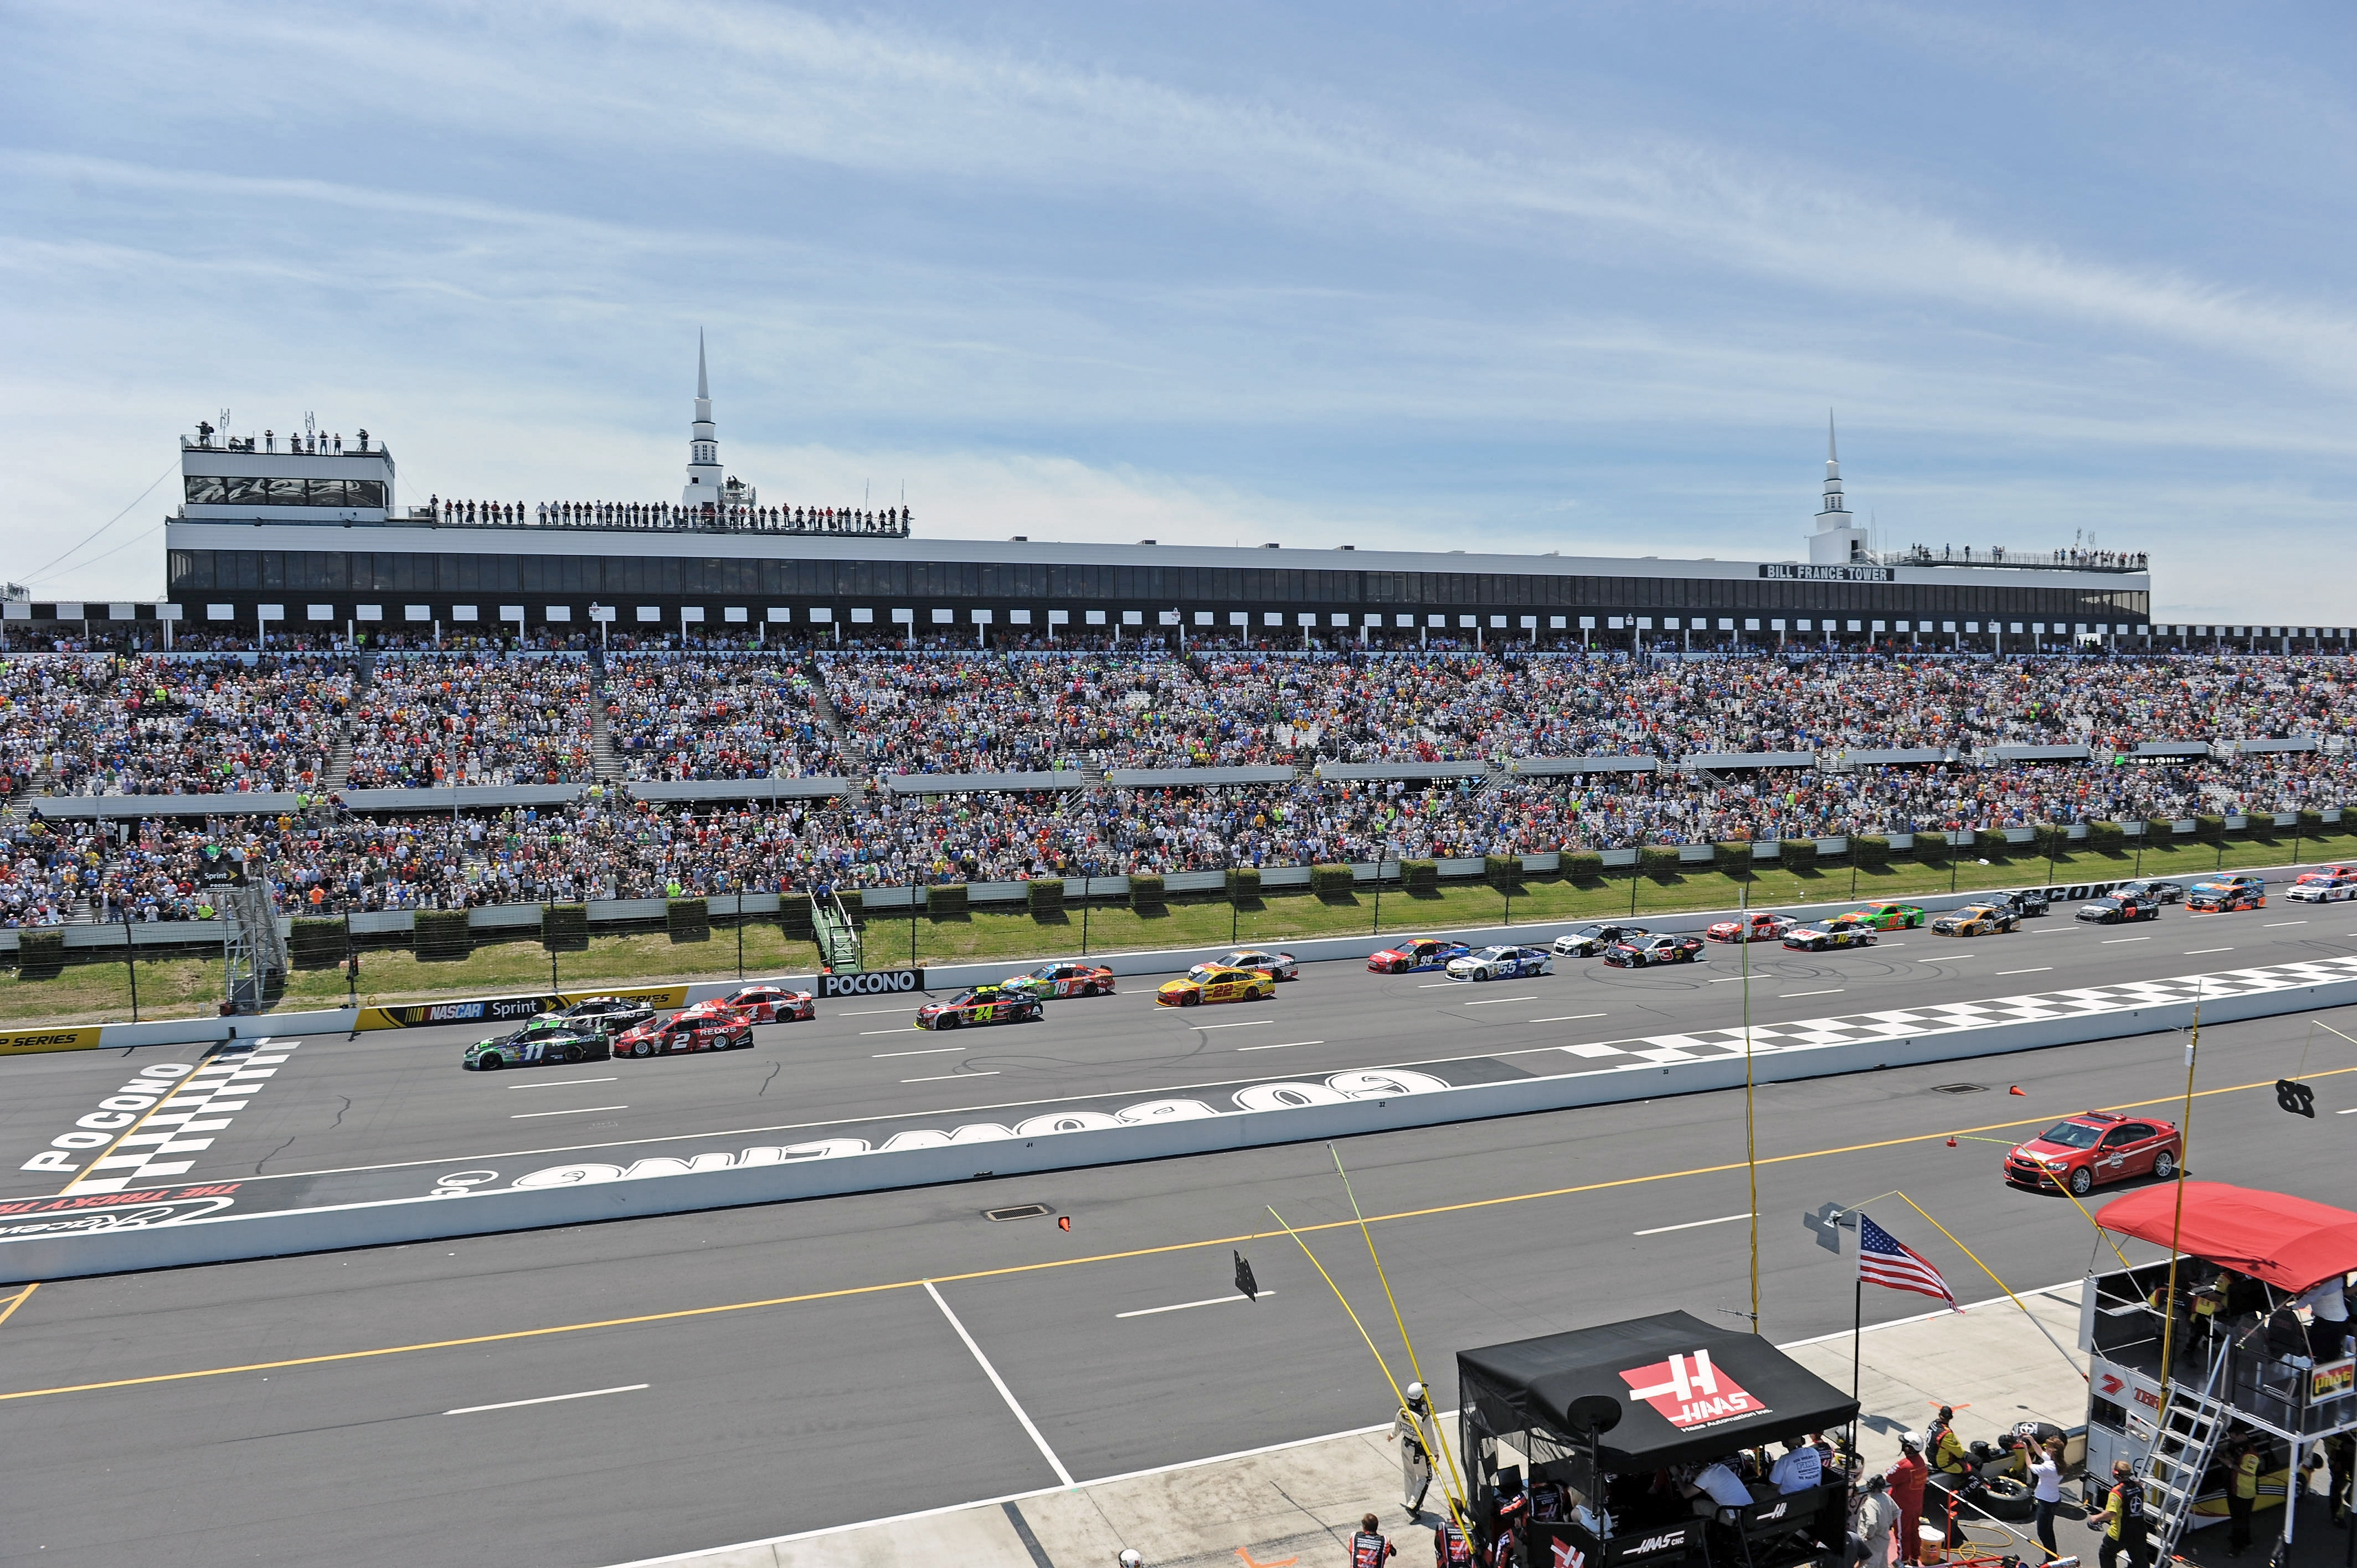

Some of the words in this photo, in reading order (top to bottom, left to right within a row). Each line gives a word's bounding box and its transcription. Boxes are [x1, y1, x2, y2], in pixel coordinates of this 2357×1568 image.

[1767, 565, 1793, 578] BILL
[1797, 566, 1844, 579] FRANCE
[1847, 568, 1887, 581] TOWER
[1757, 926, 1772, 937] 42
[1983, 919, 1994, 931] 31
[1836, 933, 1849, 944] 16
[1419, 955, 1434, 967] 99
[1658, 948, 1674, 962] 3
[1499, 960, 1518, 975] 55
[826, 971, 915, 996] POCONO
[1053, 981, 1070, 994] 18
[1212, 984, 1234, 997] 22
[430, 1003, 482, 1020] NASCAR
[492, 1000, 537, 1018] Sprint
[748, 1005, 759, 1019] 4
[974, 1005, 994, 1021] 24
[699, 1027, 737, 1036] REDDS
[12, 1034, 78, 1047] SERIES
[672, 1033, 691, 1049] 2
[525, 1043, 545, 1060] 11
[19, 1063, 194, 1172] POCONO
[173, 1183, 242, 1199] THE
[35, 1190, 169, 1211] TRICKY
[2100, 1374, 2125, 1396] 7
[1667, 1391, 1751, 1422] HAAS
[1680, 1424, 1706, 1432] Haas
[1707, 1410, 1757, 1427] Automation
[1623, 1530, 1685, 1554] HAAS
[1671, 1537, 1684, 1546] CNC
